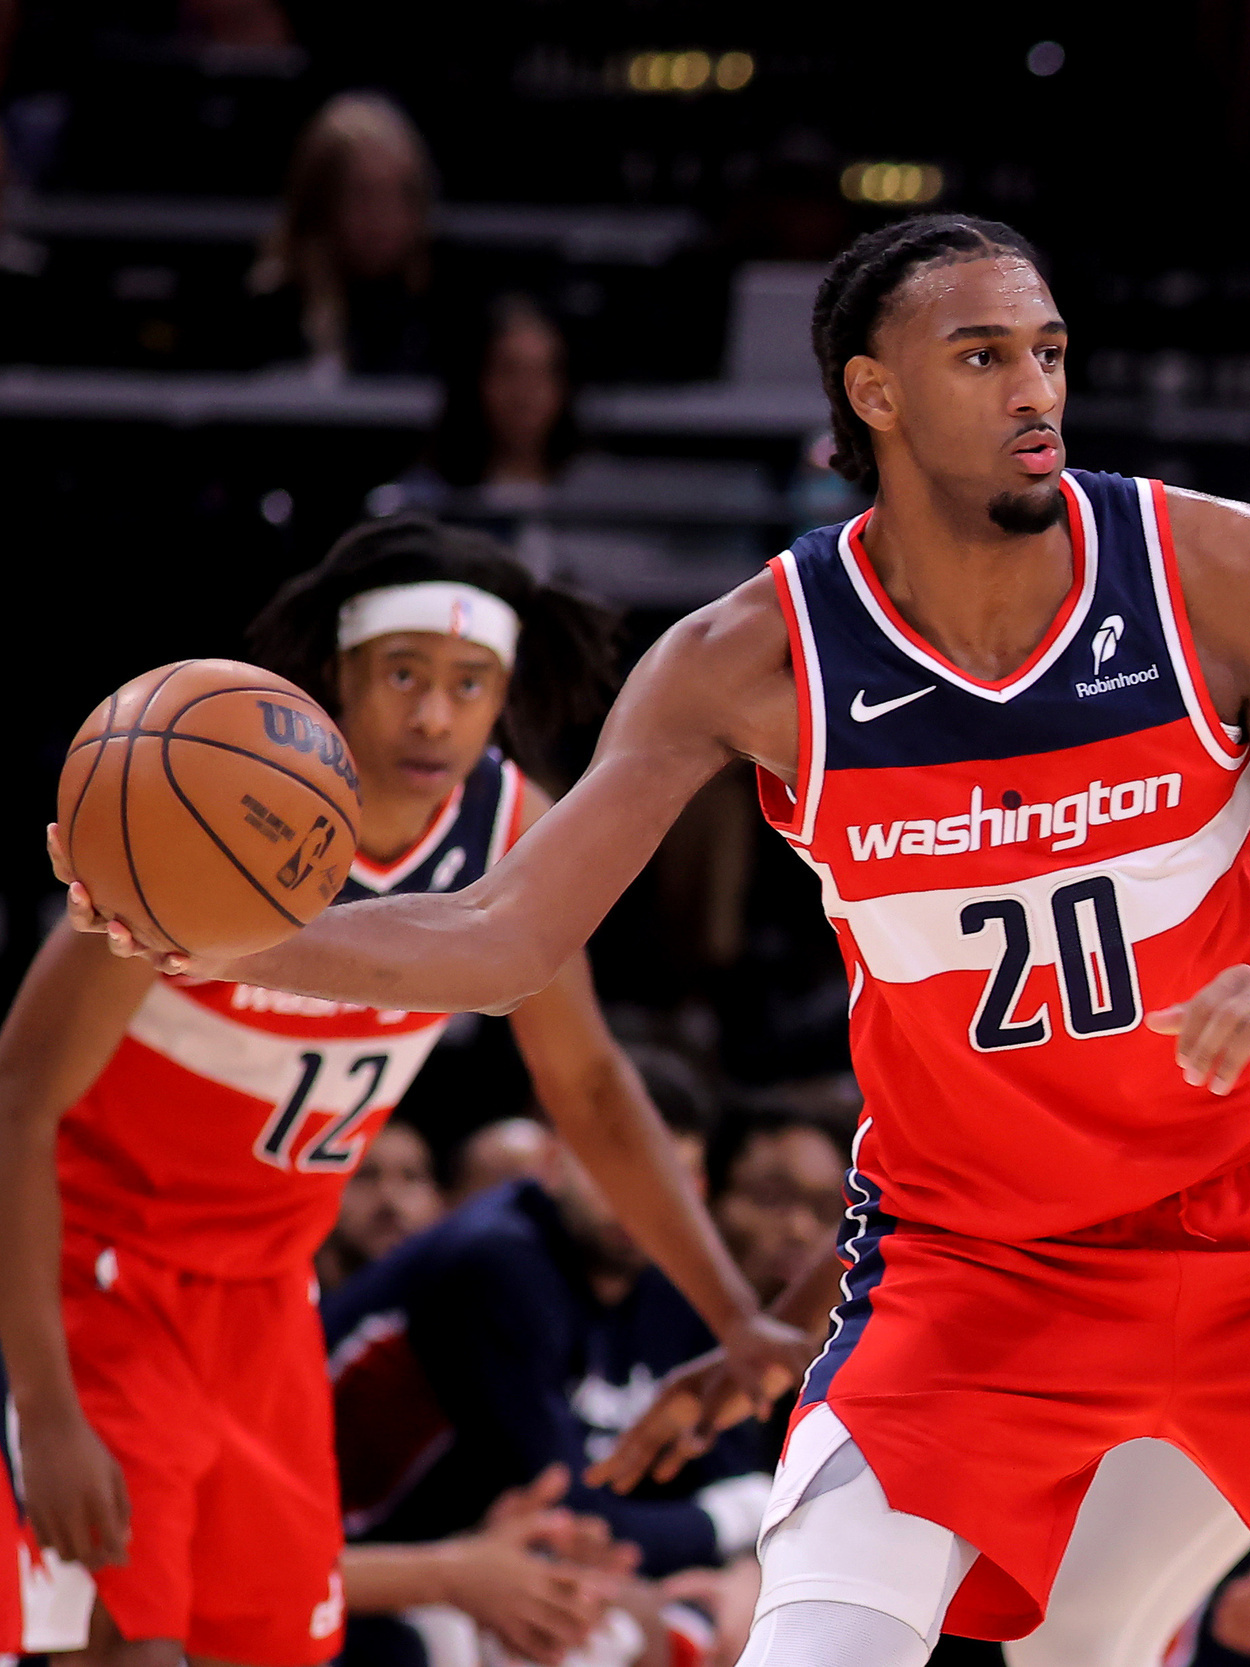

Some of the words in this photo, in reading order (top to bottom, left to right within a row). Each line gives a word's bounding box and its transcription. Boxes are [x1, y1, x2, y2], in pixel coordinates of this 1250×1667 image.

[1075, 663, 1160, 698] Robinhood
[846, 772, 1183, 861] washington
[958, 871, 1143, 1053] 20
[252, 1051, 389, 1173] 12
